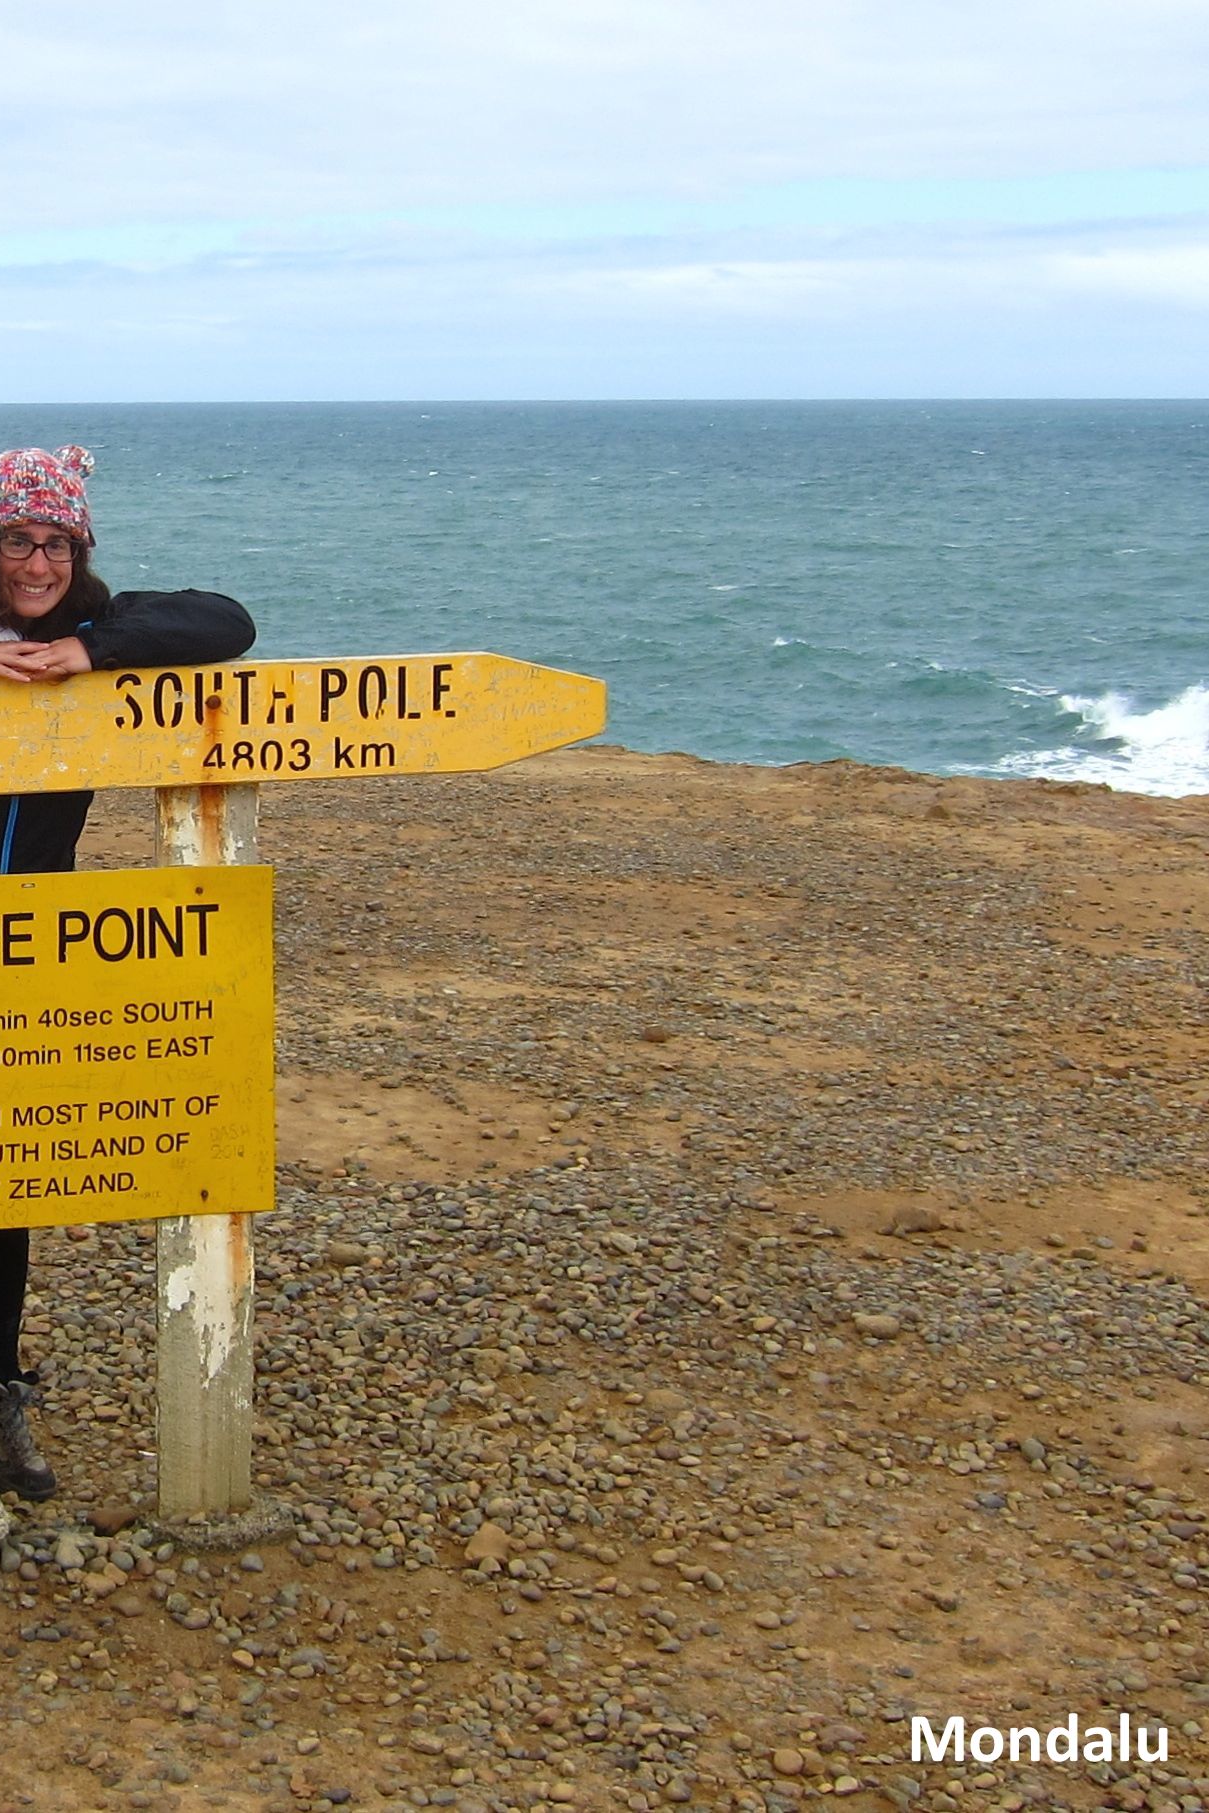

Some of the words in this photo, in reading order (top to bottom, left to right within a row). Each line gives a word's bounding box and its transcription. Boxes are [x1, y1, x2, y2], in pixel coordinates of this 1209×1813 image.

[114, 669, 295, 730] SOUTH
[320, 663, 456, 722] POLE
[202, 738, 311, 772] 4803
[334, 736, 395, 769] km
[58, 903, 219, 964] POINT
[38, 1008, 113, 1028] 40sec
[123, 999, 213, 1024] SOUTH
[73, 1043, 136, 1063] 11sec
[147, 1035, 214, 1059] EAST
[12, 1103, 88, 1127] MOST
[98, 1097, 176, 1122] POINT
[185, 1095, 220, 1116] OF
[51, 1135, 145, 1161] ISLAND
[155, 1132, 190, 1154] OF
[9, 1172, 138, 1200] ZEALAND.
